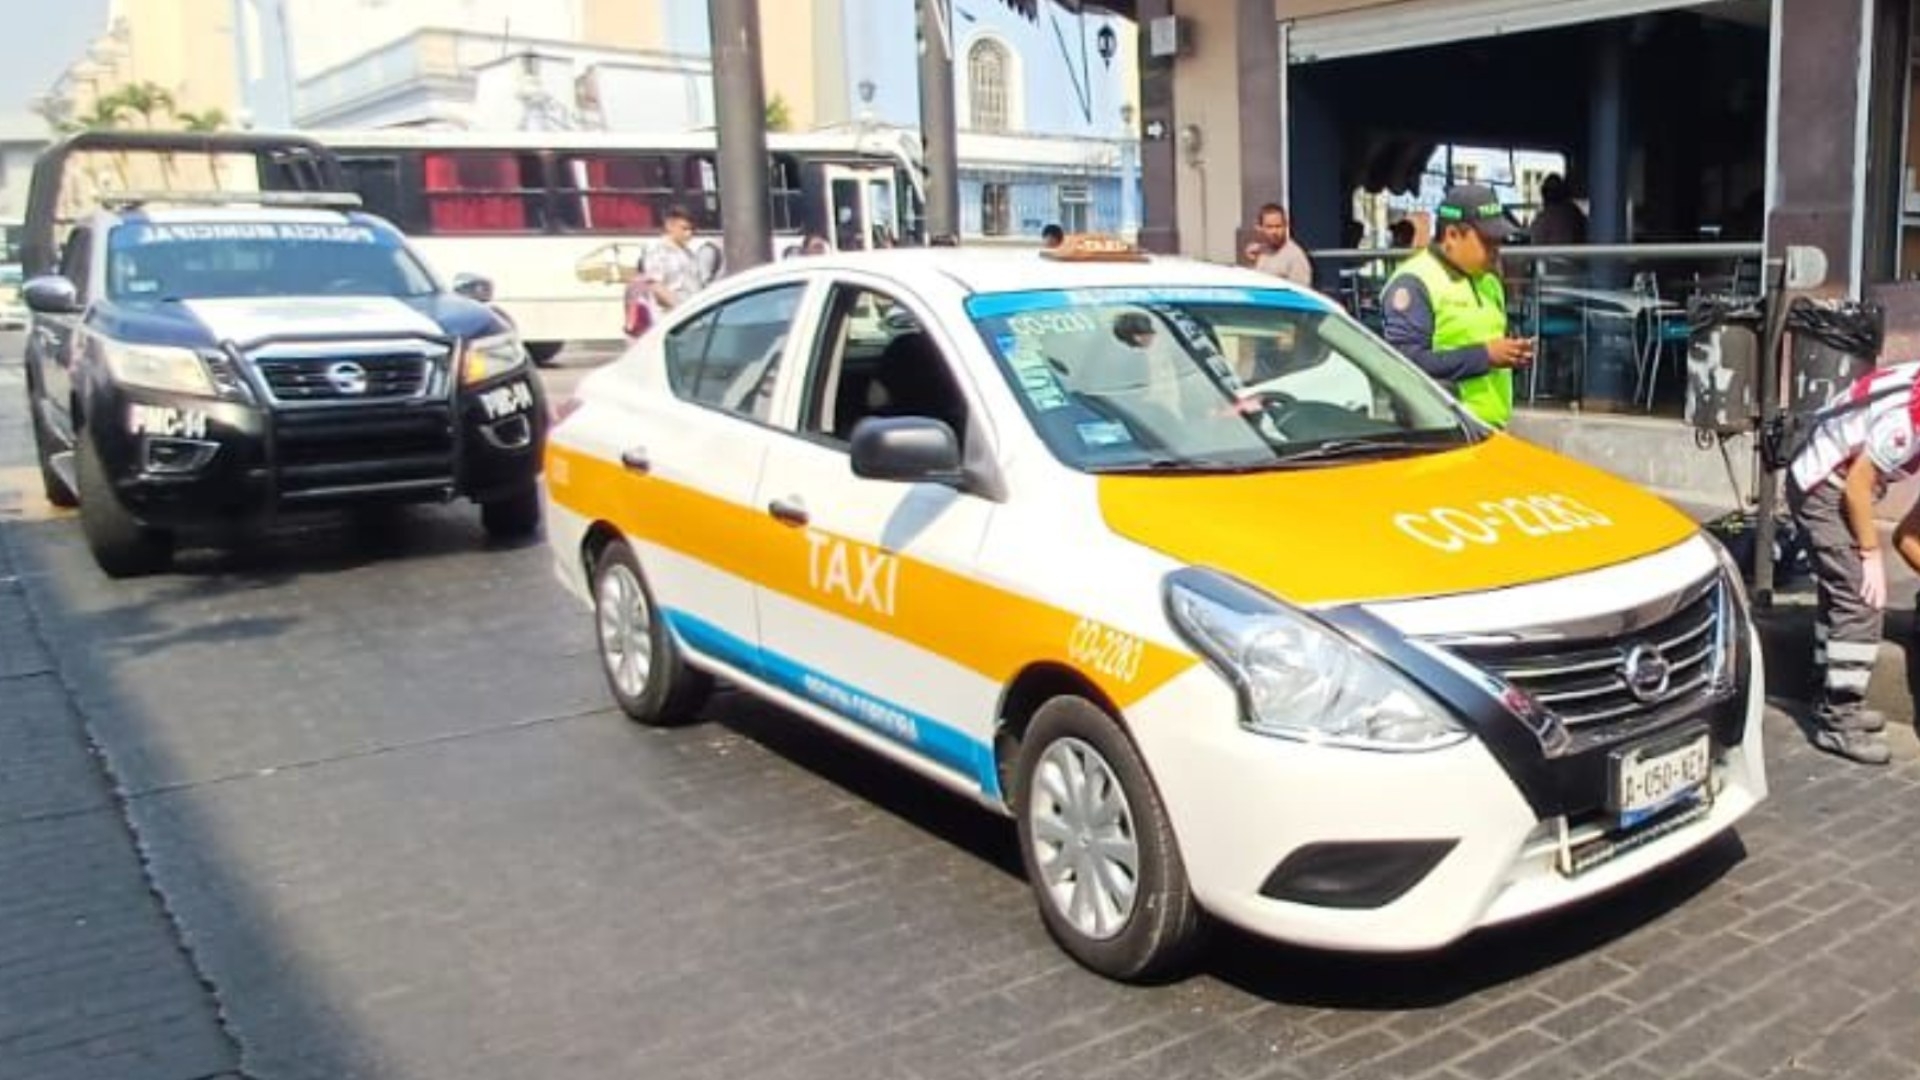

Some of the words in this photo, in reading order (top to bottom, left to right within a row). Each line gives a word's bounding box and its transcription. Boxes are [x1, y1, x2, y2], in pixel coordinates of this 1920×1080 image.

[1393, 493, 1615, 552] CO-2283
[805, 530, 899, 616] TAXI
[1068, 618, 1143, 683] CO-2283
